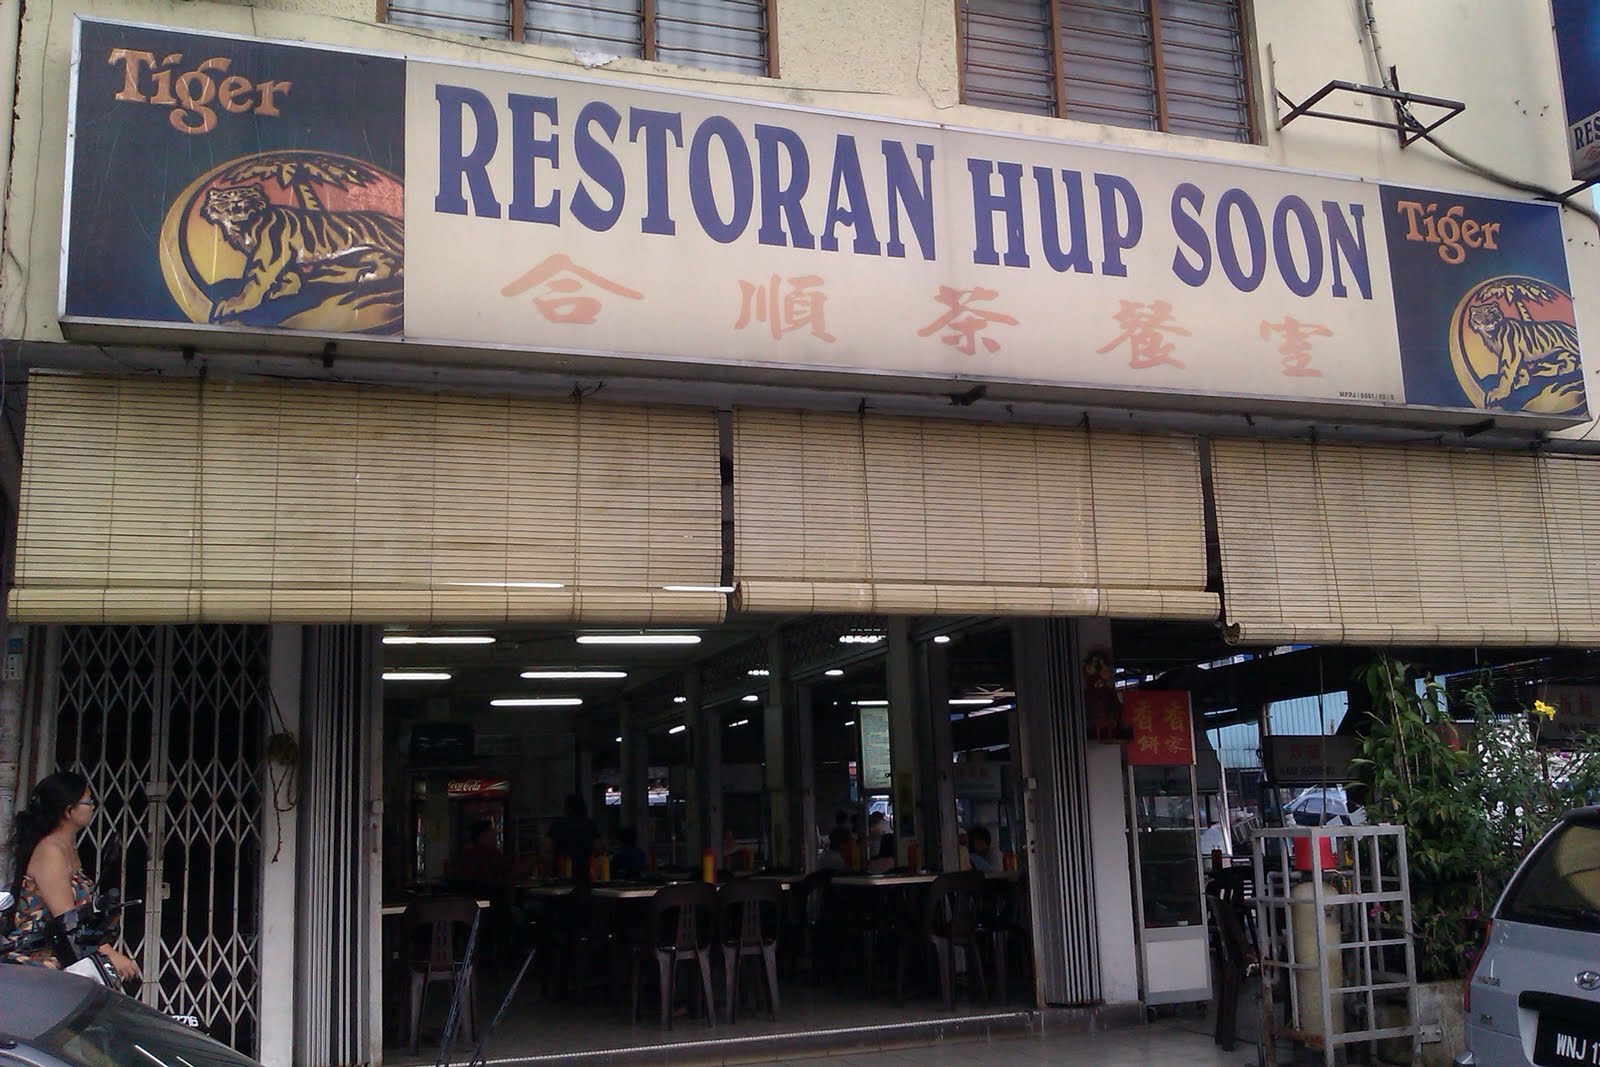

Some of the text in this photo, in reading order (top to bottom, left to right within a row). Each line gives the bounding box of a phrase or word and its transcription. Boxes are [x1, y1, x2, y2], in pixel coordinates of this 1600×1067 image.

[107, 48, 292, 134] Tiger
[434, 84, 1373, 300] RESTORAN HUP SOON
[1397, 201, 1500, 264] Tiger
[1556, 1033, 1587, 1060] WNJ
